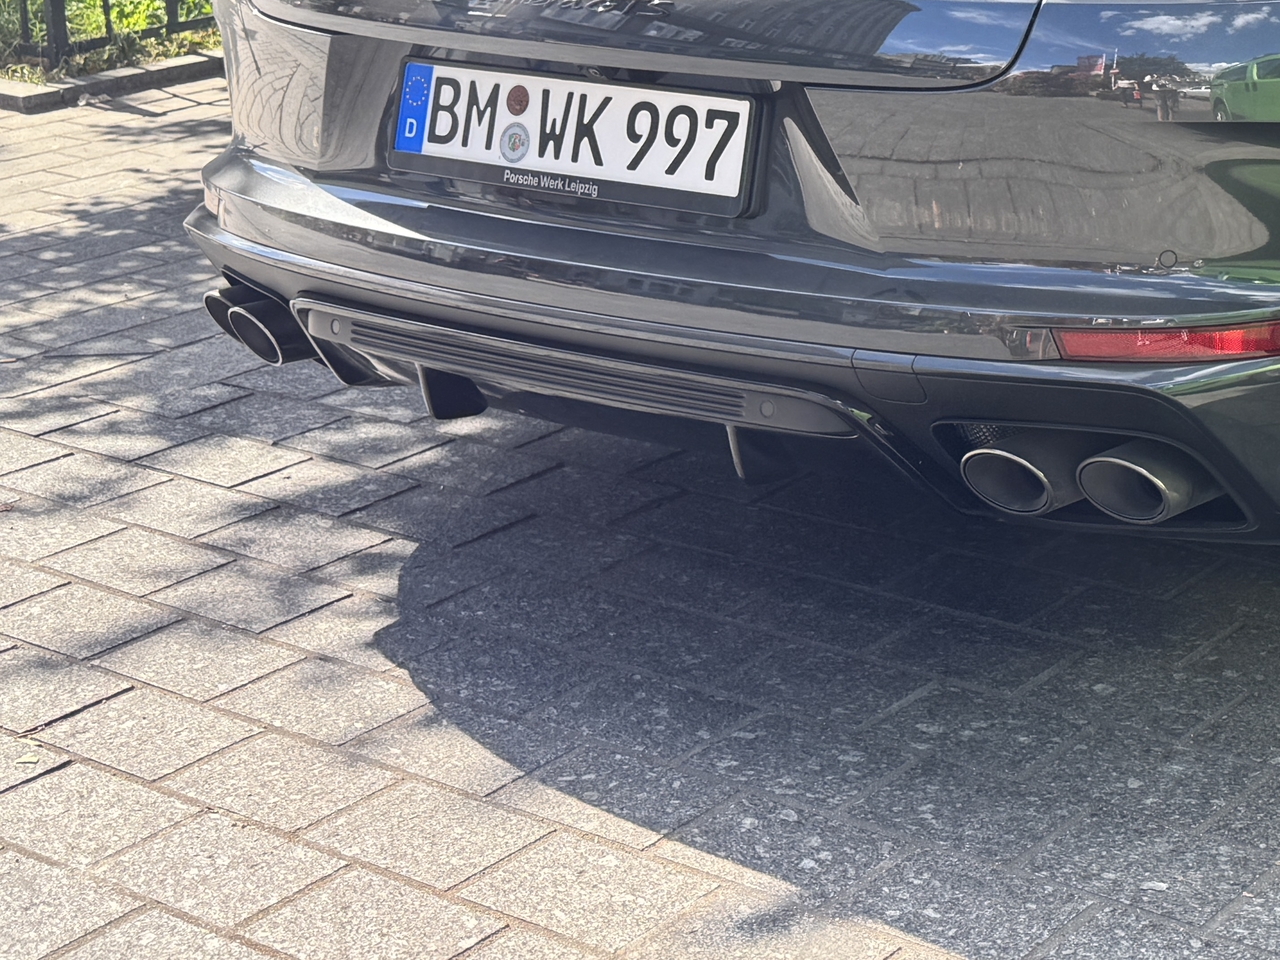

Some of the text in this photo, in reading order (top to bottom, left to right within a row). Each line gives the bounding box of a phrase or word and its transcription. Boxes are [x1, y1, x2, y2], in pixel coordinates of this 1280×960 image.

[404, 118, 417, 138] D
[427, 76, 501, 151] BM
[537, 88, 613, 167] WK
[625, 100, 741, 181] 997
[503, 169, 599, 198] Porsche Werk Leipzig
